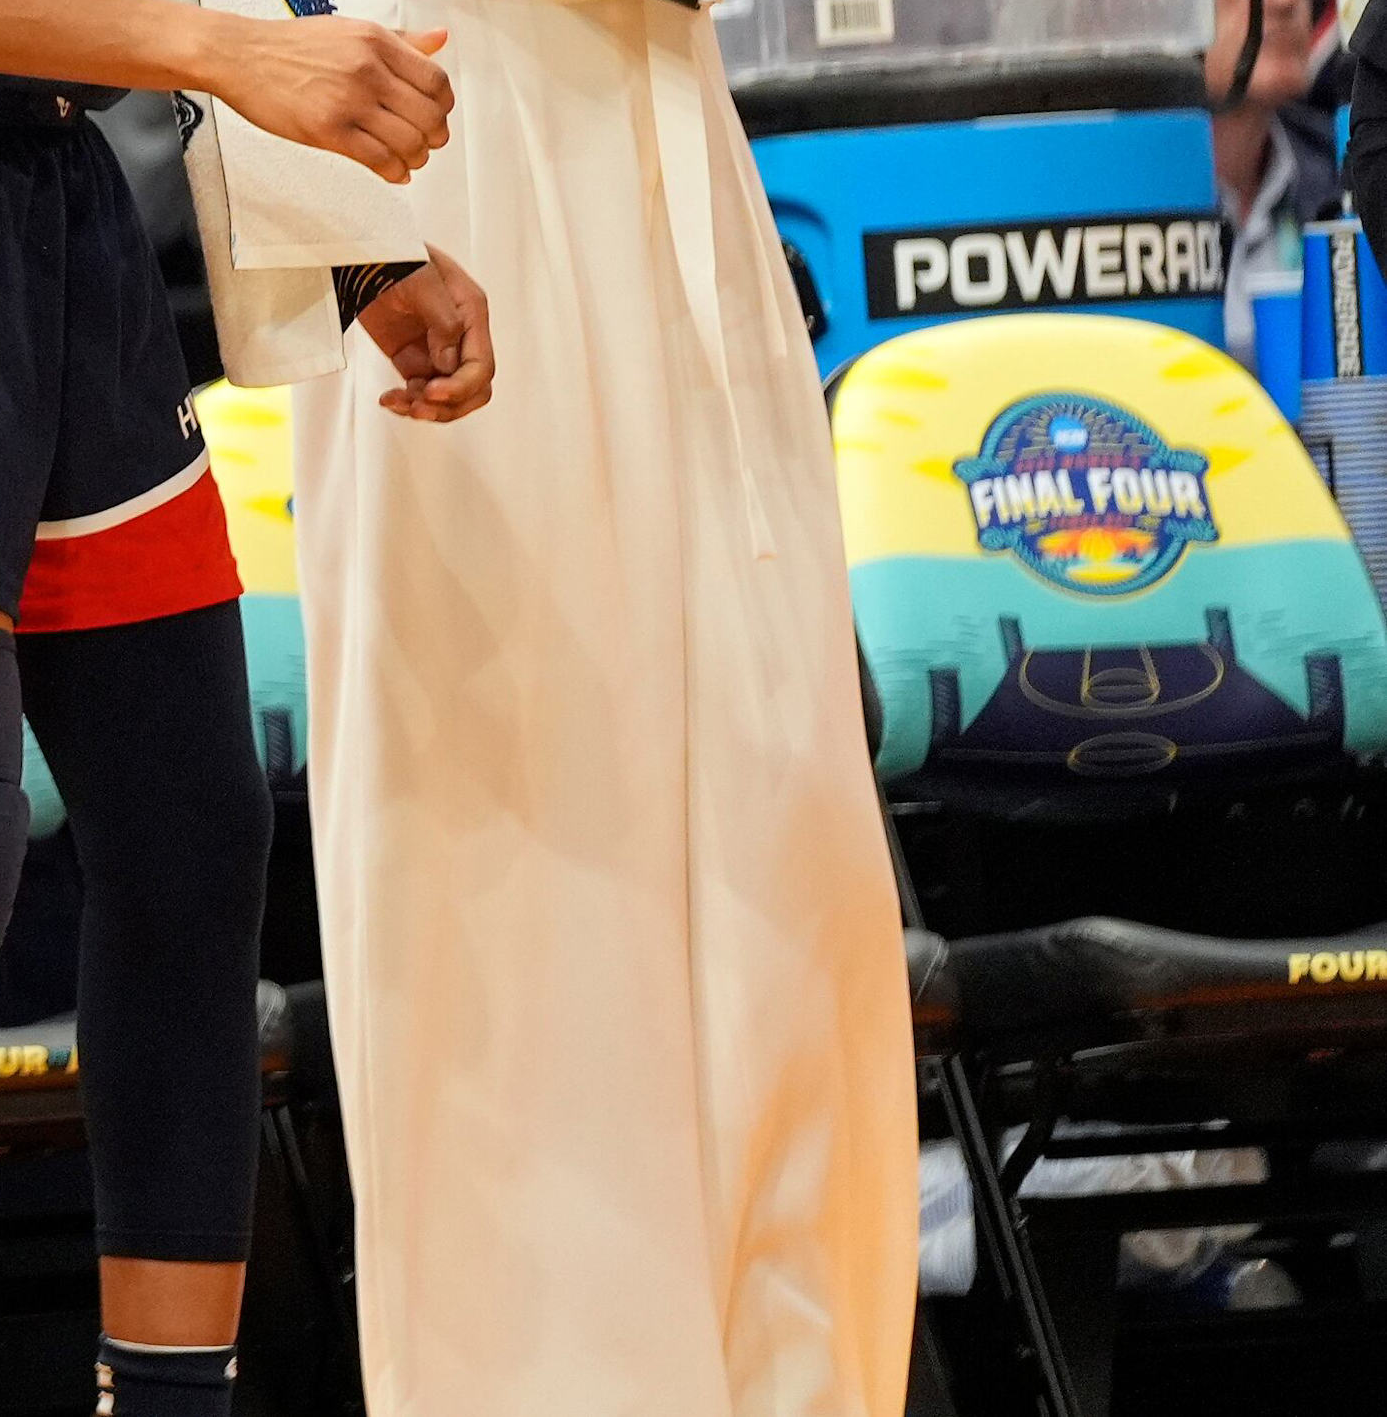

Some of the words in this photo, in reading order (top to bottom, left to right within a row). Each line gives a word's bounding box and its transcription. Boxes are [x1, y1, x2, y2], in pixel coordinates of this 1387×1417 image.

[893, 220, 1222, 312] POWERAD
[971, 468, 1086, 529] FINAL
[1087, 467, 1208, 519] FOUR
